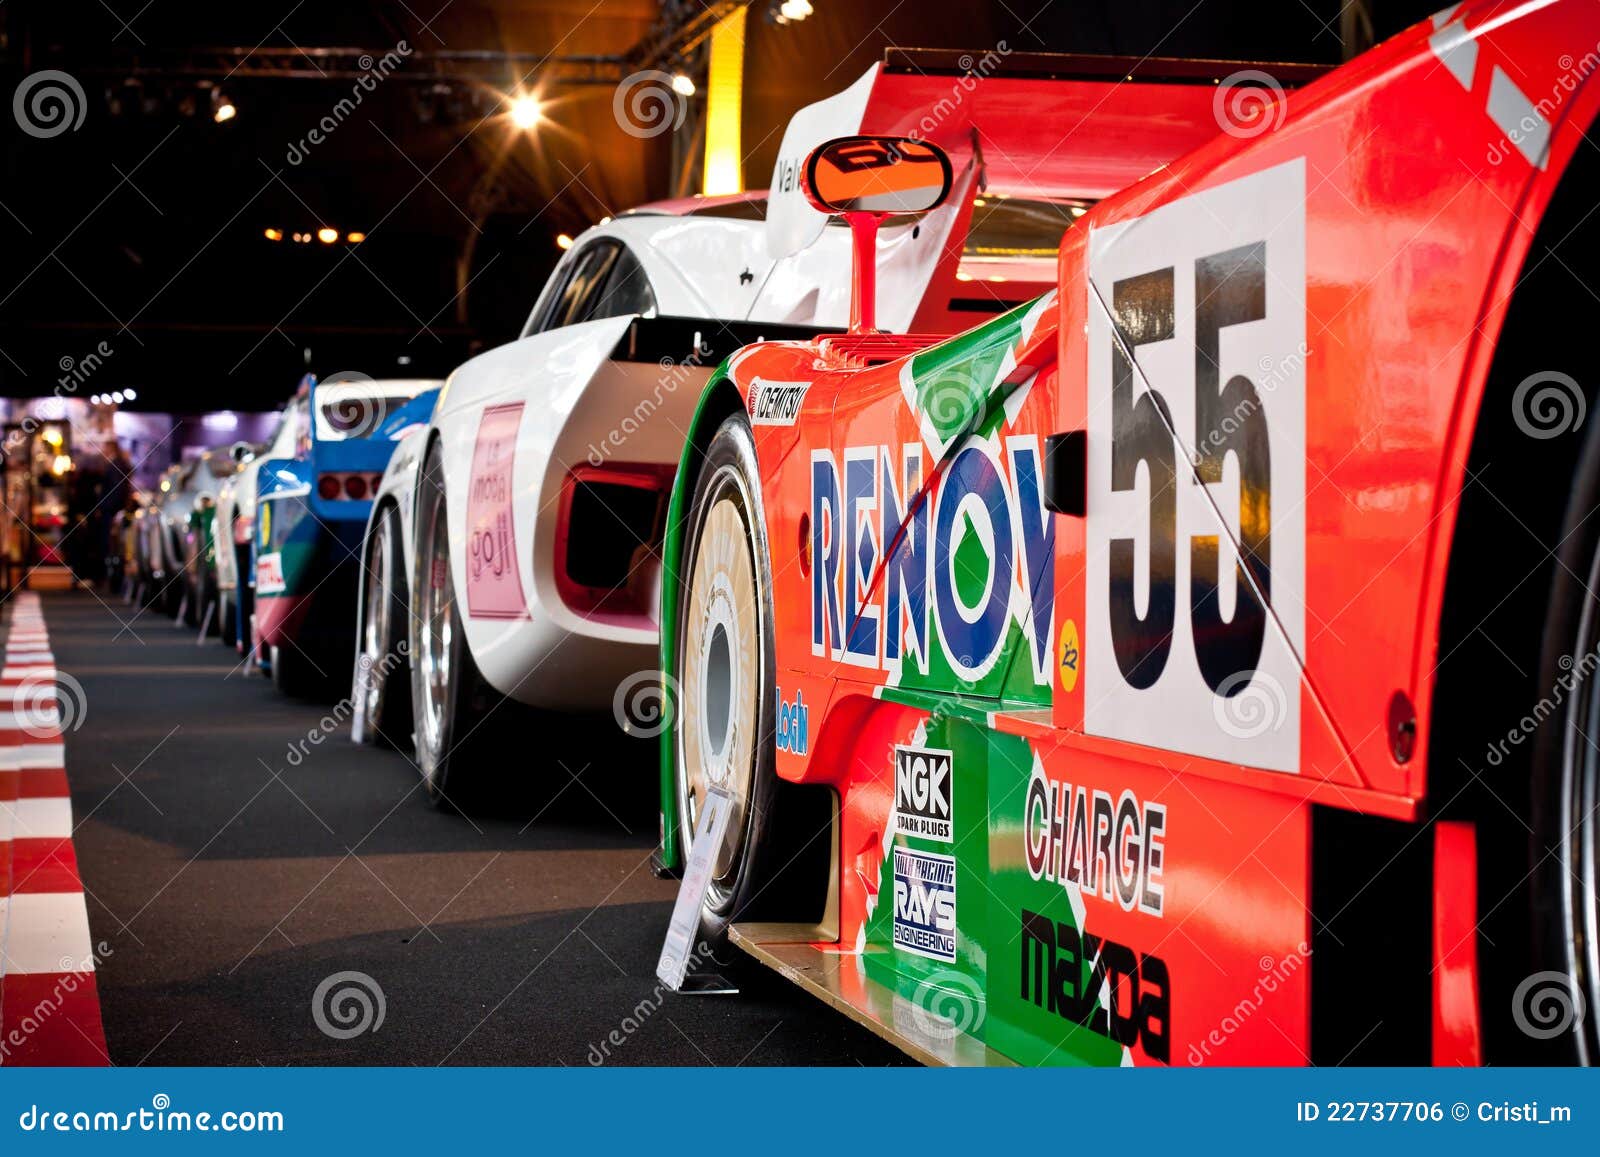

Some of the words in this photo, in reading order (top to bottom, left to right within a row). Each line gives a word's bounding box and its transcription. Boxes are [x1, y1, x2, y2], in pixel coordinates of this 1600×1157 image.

[1109, 240, 1272, 698] 55
[896, 755, 949, 818] NGK
[897, 815, 919, 833] SPARK
[920, 821, 950, 837] PLUGS
[1024, 774, 1167, 918] CHARGE
[915, 860, 954, 884] RACING
[895, 880, 954, 931] RAYS
[895, 924, 954, 952] ENGINEERING
[1021, 909, 1171, 1065] mazda
